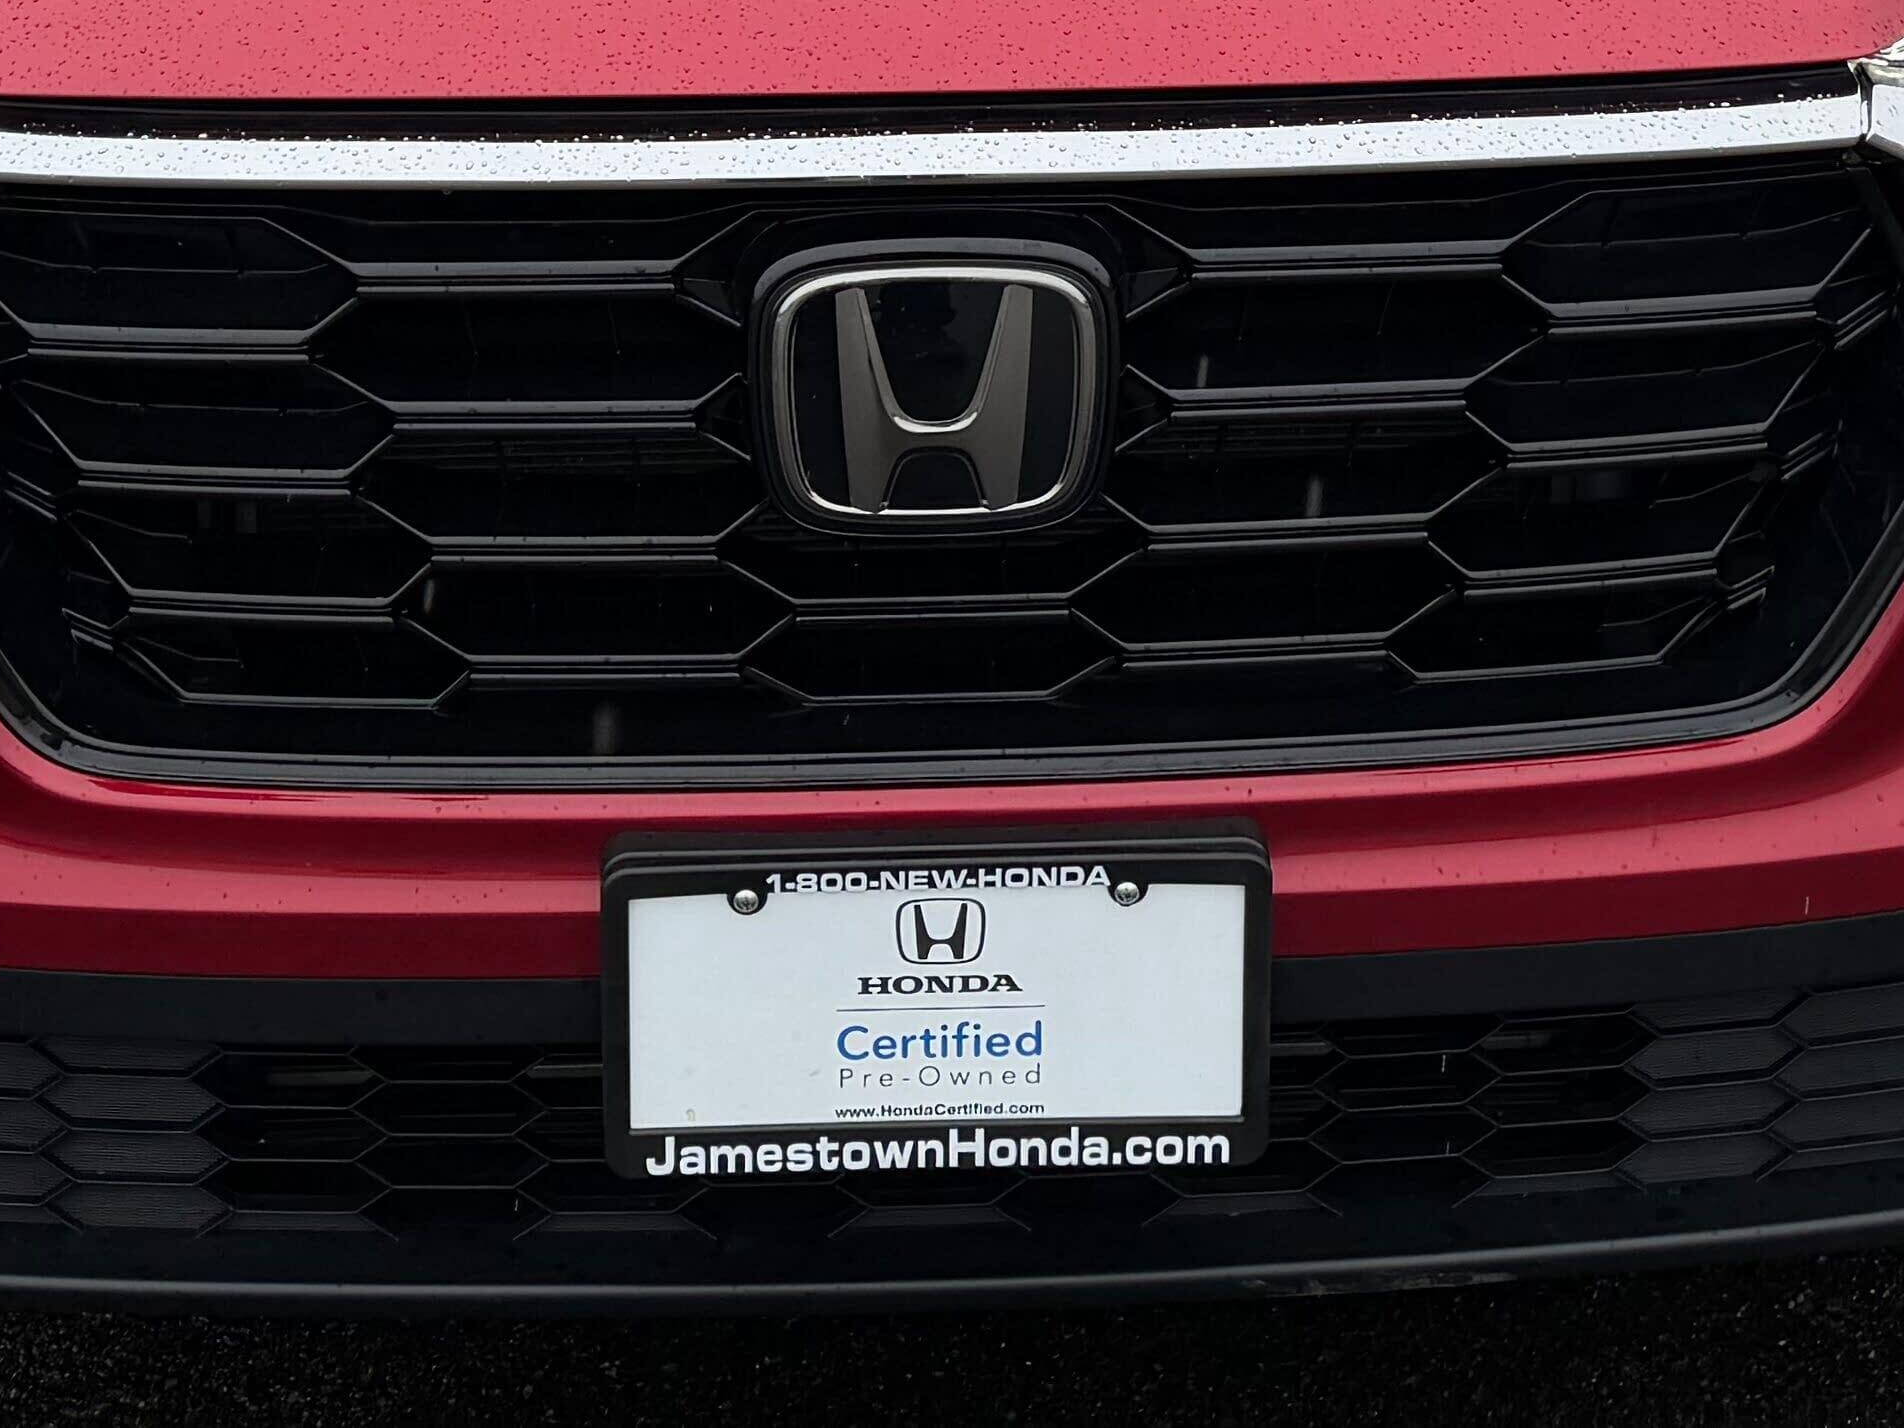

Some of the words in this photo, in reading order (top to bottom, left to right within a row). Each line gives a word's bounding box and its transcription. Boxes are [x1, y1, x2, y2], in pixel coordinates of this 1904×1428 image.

[765, 865, 1111, 894] 1-800-NEW-HONDA
[856, 974, 1023, 995] HONDA
[837, 1020, 1043, 1061] Certified
[839, 1062, 1041, 1089] Pre-Owned
[834, 1102, 1045, 1118] www.HondaCertified.com
[646, 1126, 1230, 1177] JamestownHonda.com
